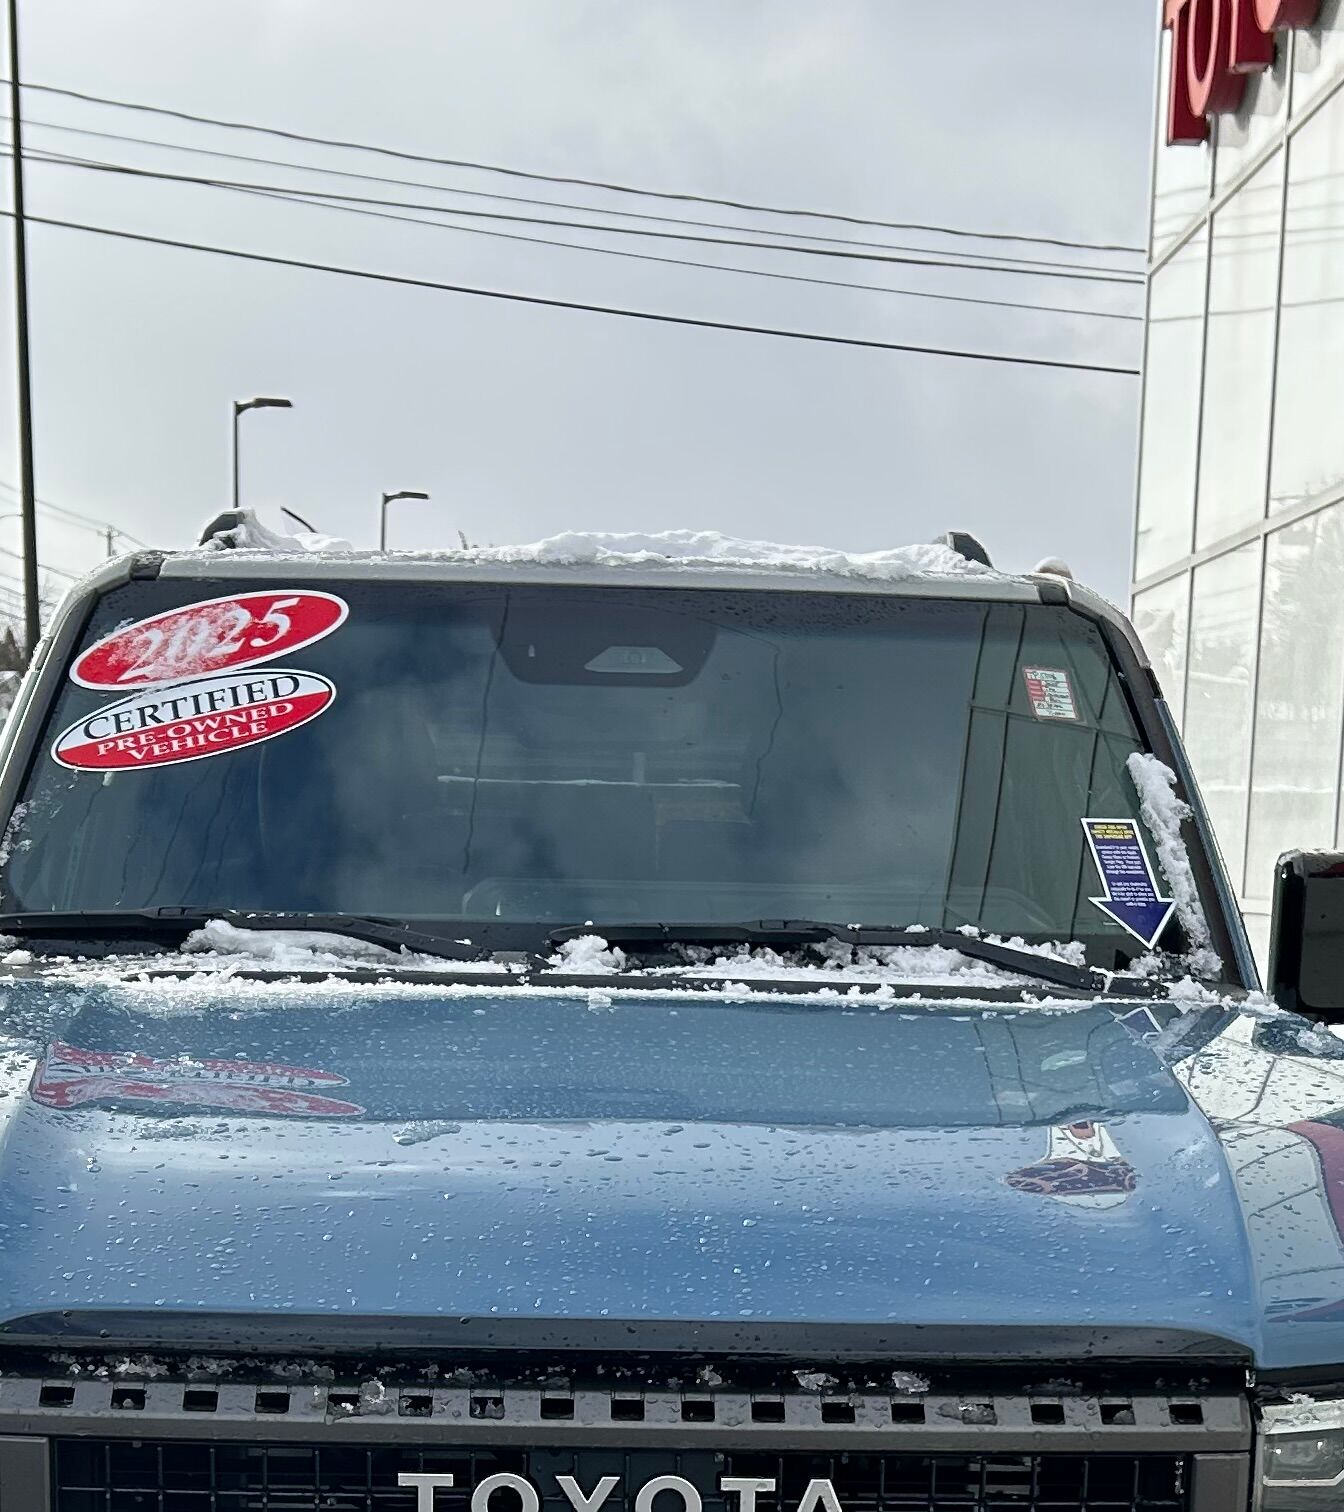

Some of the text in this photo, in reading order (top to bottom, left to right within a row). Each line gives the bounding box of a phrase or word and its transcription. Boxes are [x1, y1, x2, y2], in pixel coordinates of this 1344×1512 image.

[84, 675, 300, 740] CERTIFIED
[97, 702, 294, 757] PRE-OWNED
[127, 721, 269, 761] VEHICLE
